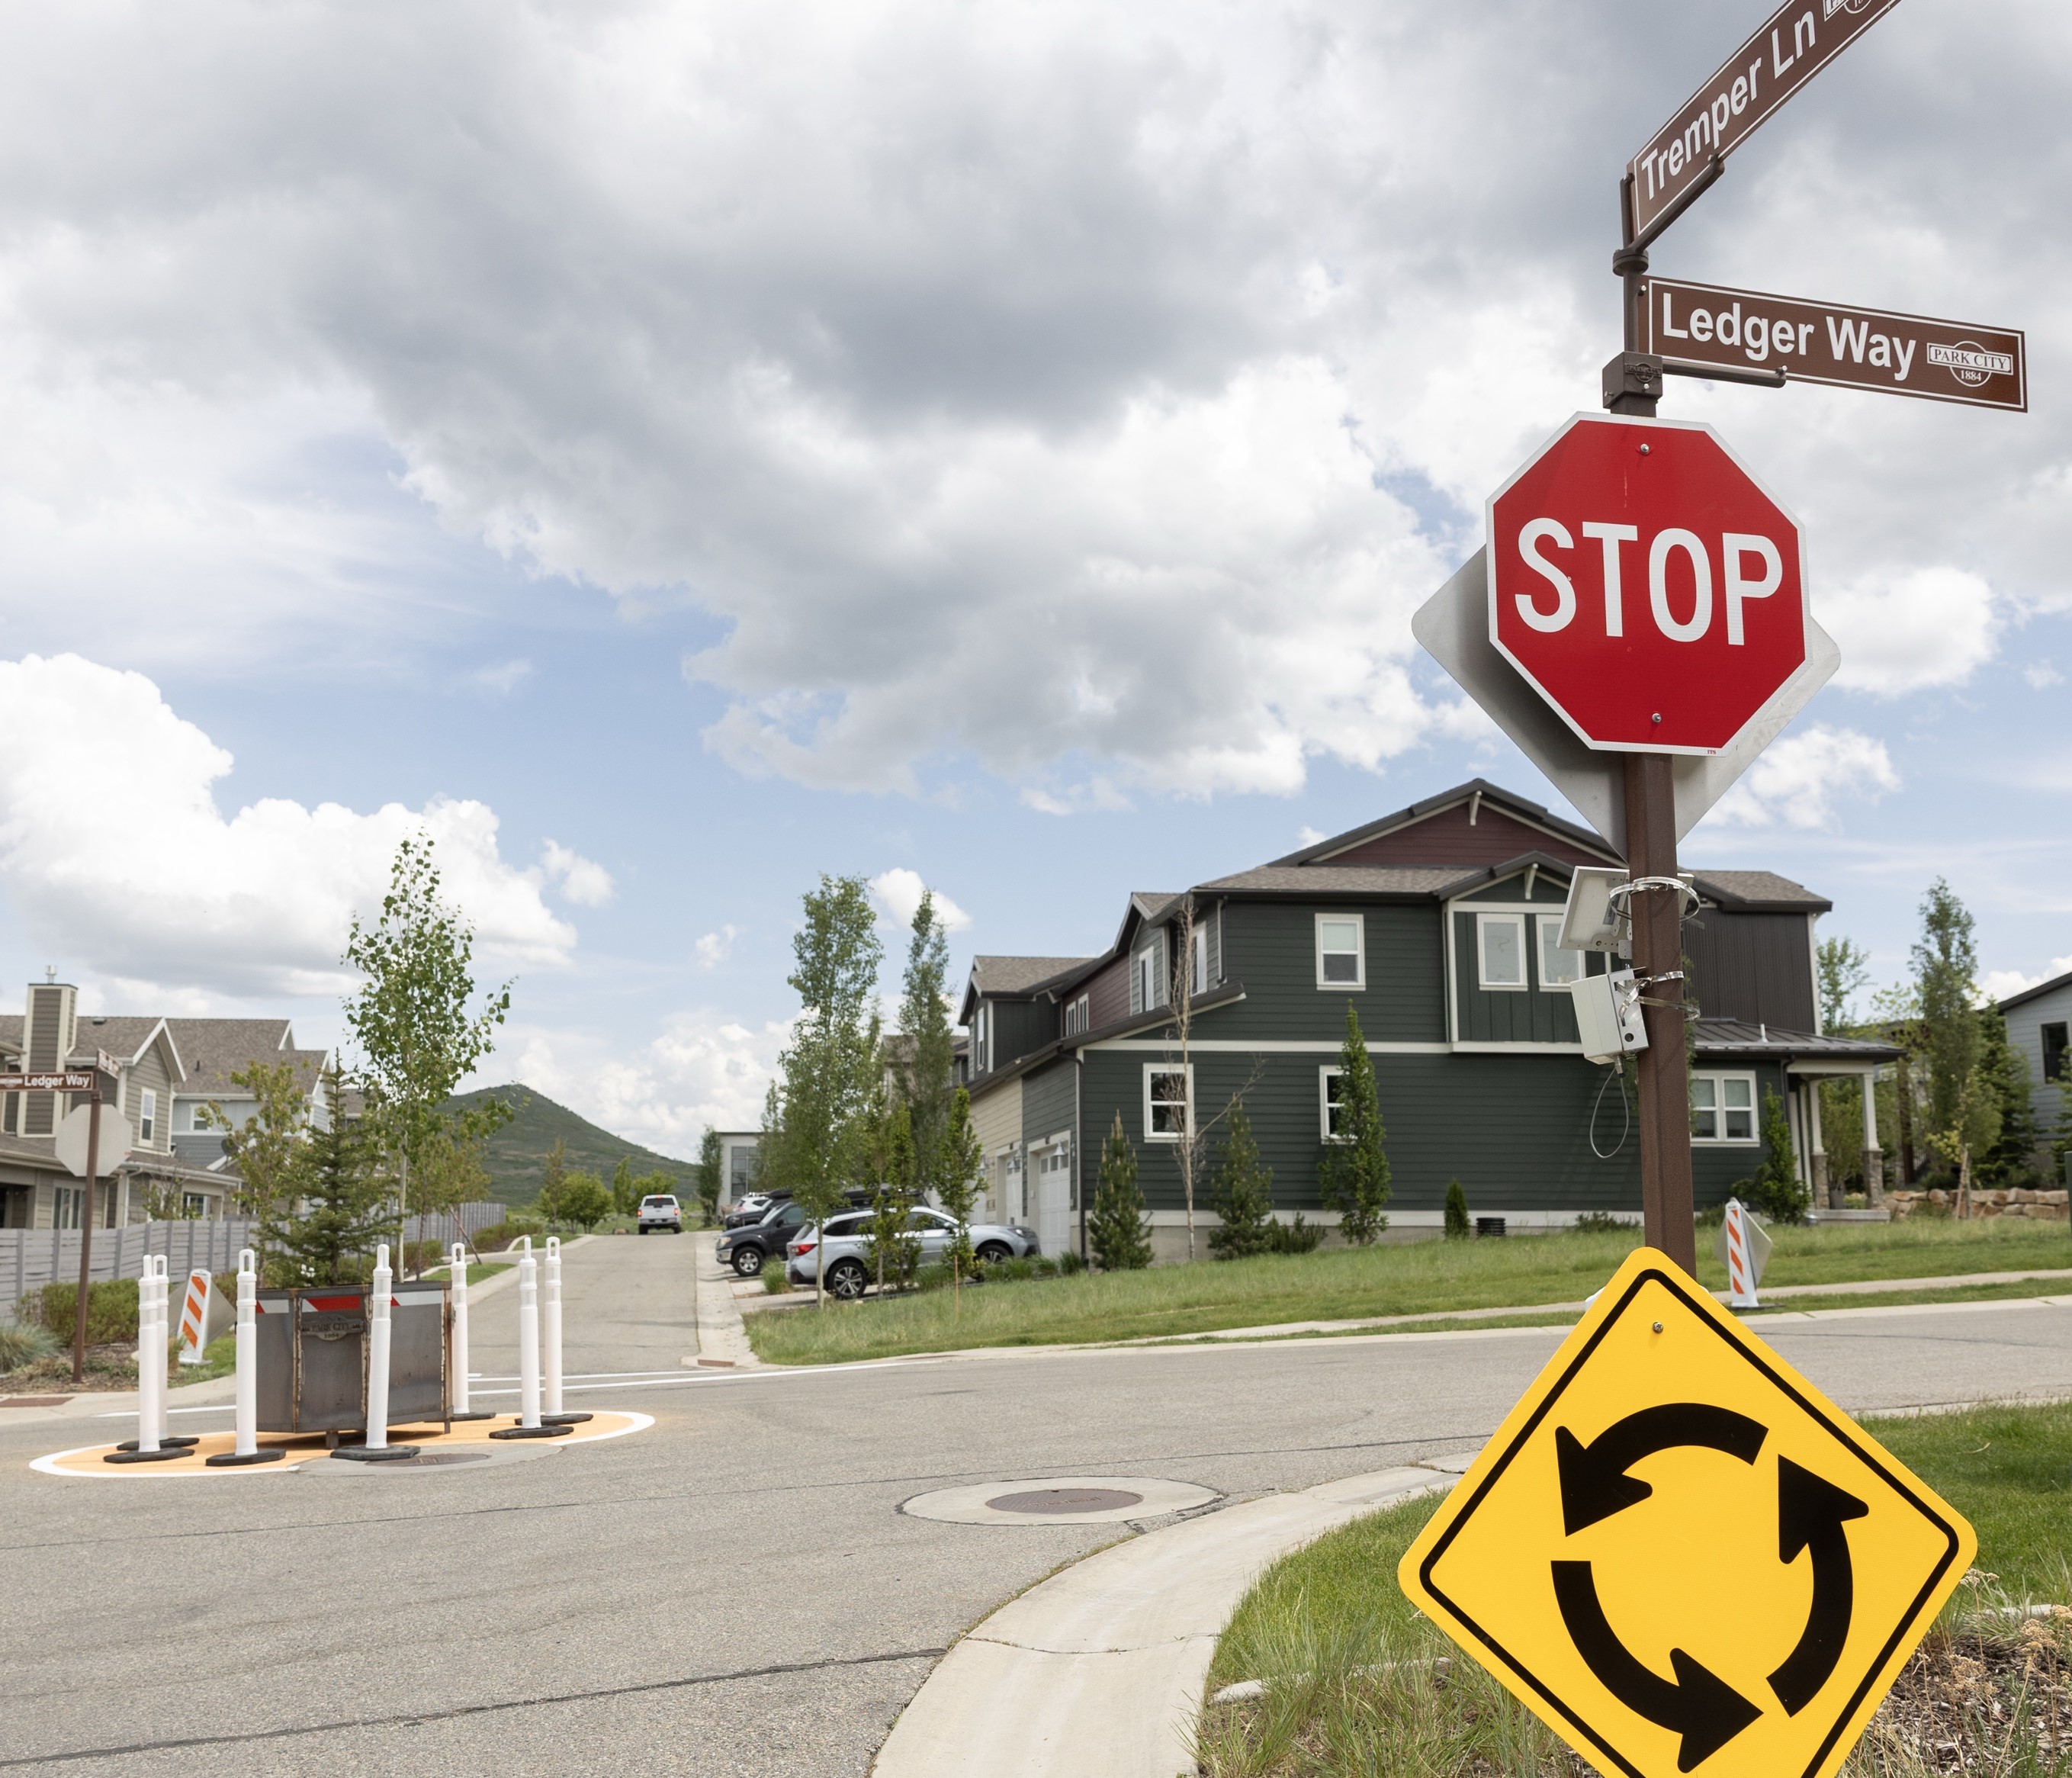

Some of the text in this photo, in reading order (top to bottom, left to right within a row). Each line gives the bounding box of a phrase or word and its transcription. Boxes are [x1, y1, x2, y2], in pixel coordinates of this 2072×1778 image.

[1641, 10, 1816, 200] Tremper Ln
[1662, 292, 1916, 382] Ledger Way
[1934, 349, 2006, 369] PARK CITY
[1960, 370, 1982, 381] 1884
[1515, 517, 1783, 646] STOP
[24, 1075, 64, 1088] Ledger
[66, 1075, 90, 1088] Way
